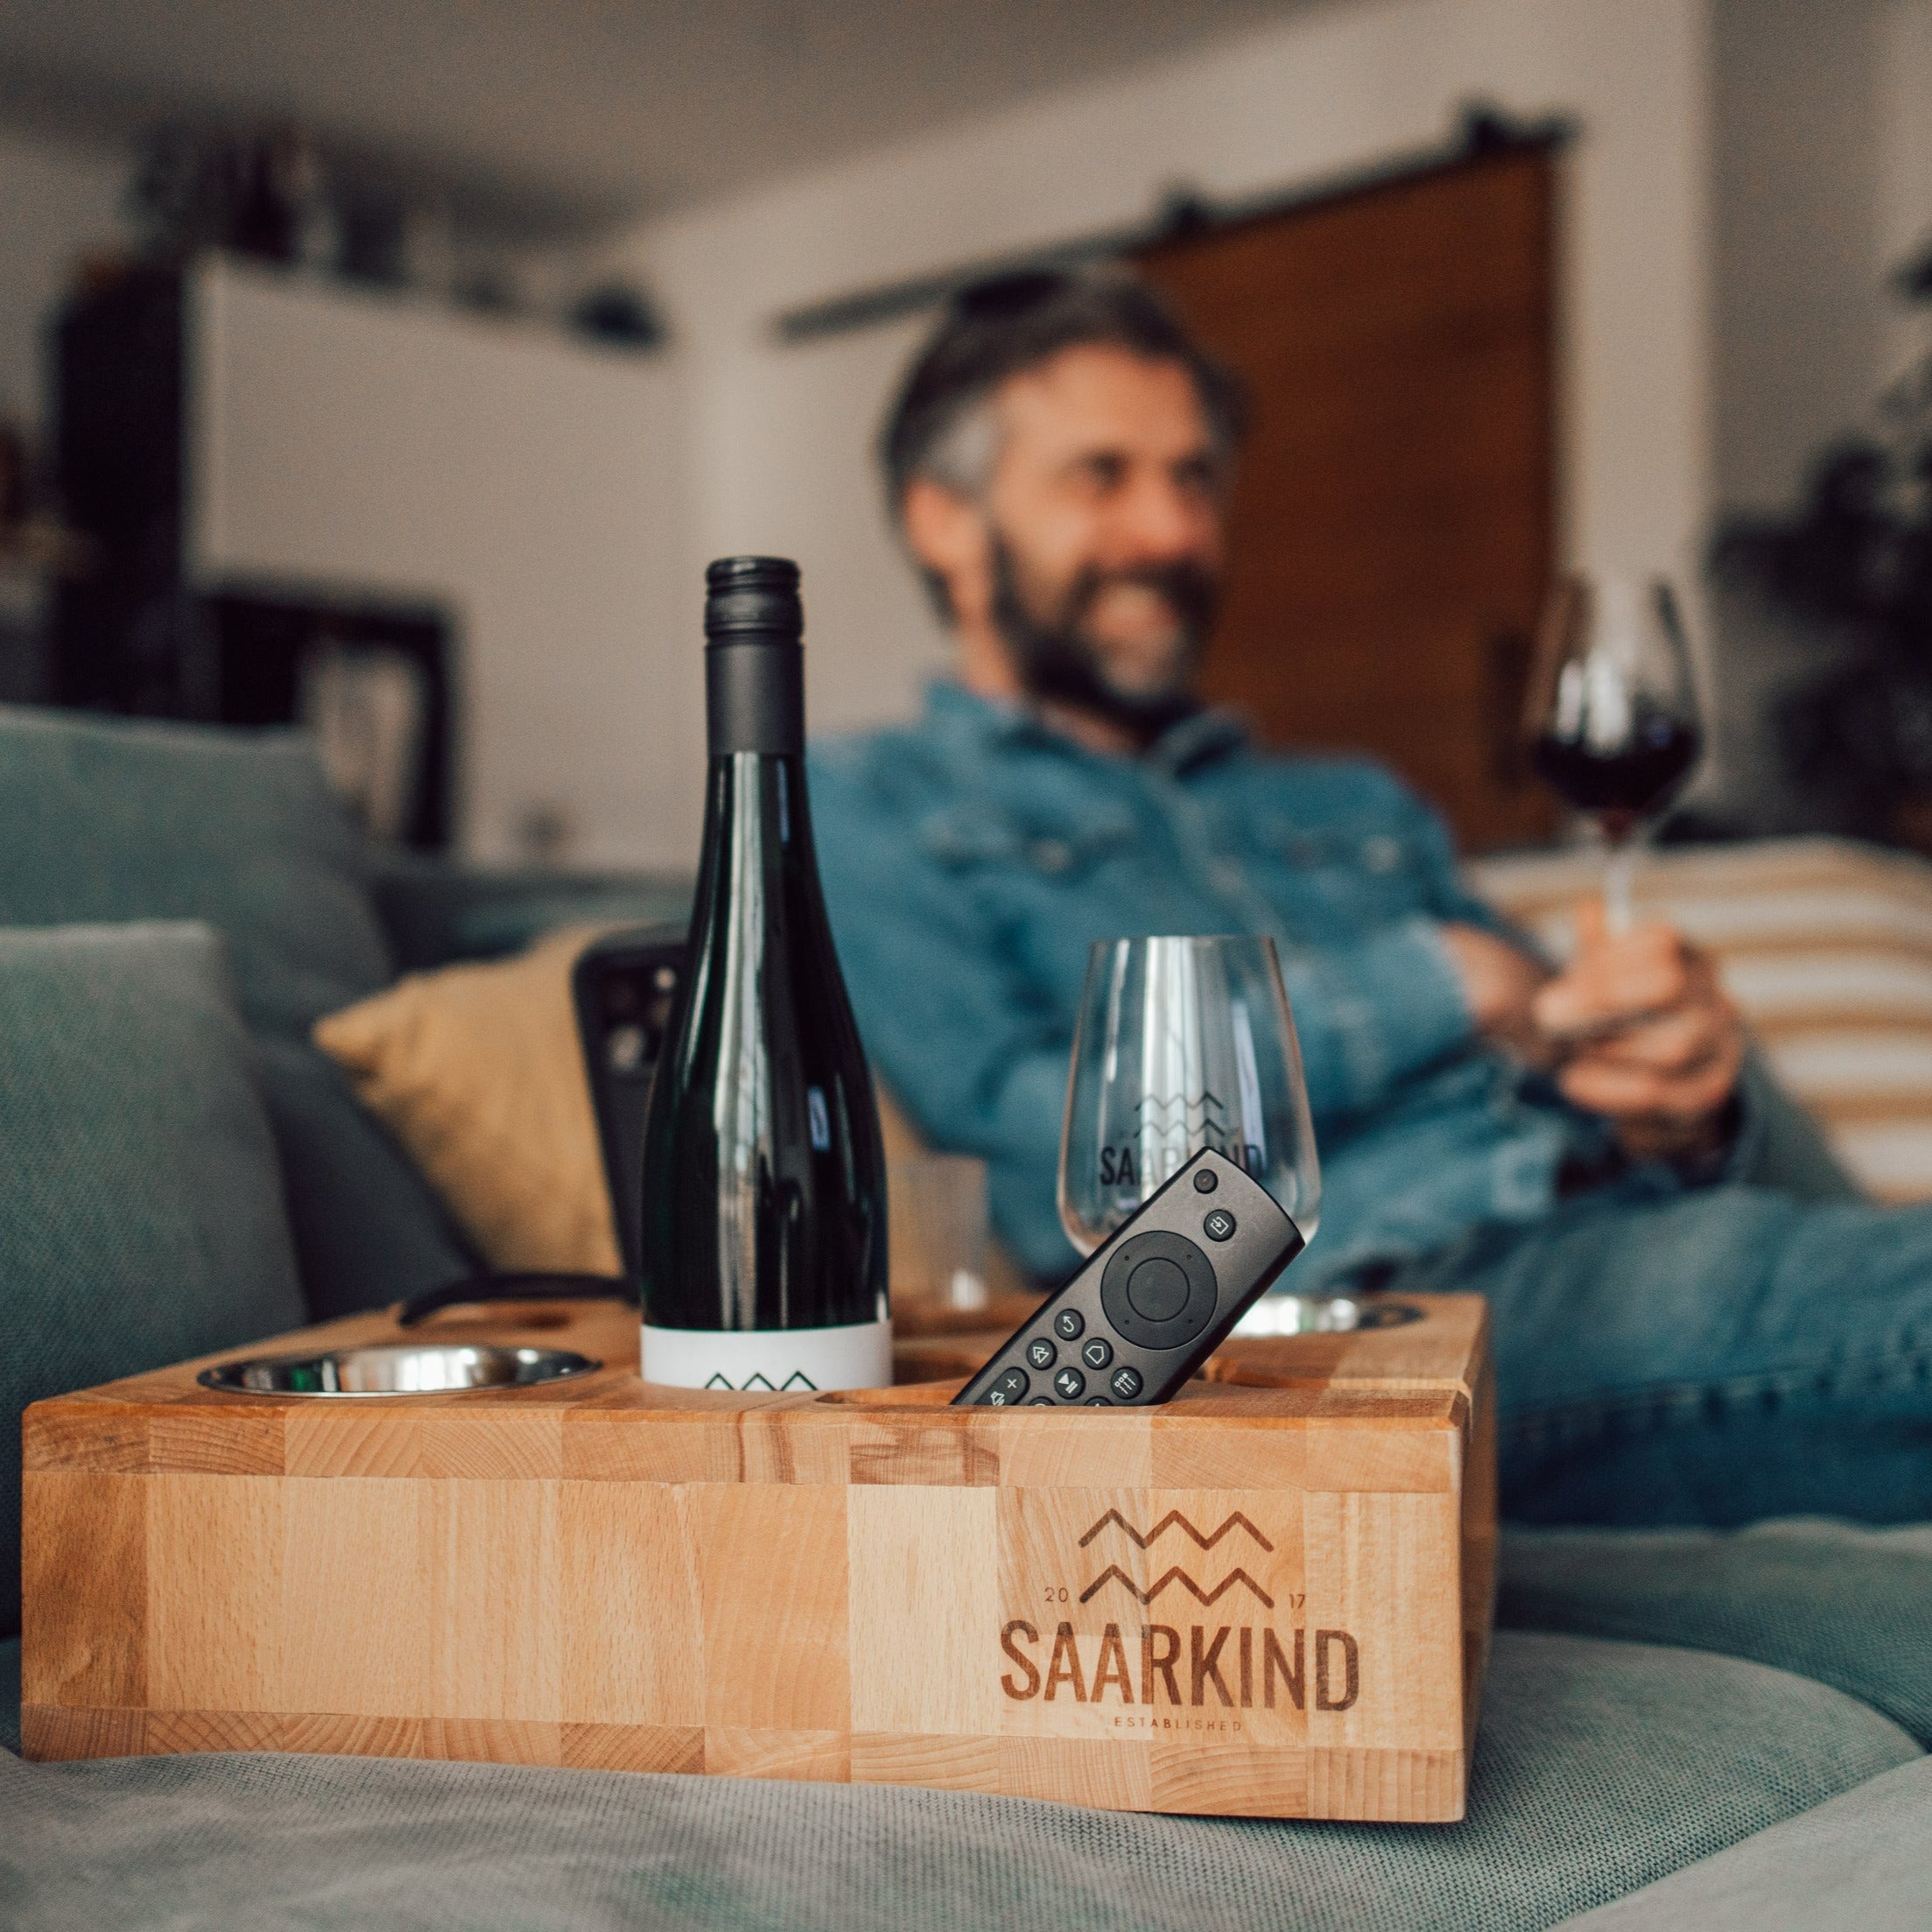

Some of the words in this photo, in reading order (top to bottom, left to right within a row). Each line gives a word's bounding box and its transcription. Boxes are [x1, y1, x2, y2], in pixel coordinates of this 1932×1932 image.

[1044, 1586, 1069, 1603] 20
[1289, 1593, 1305, 1609] 17
[1000, 1619, 1359, 1711] SAARKIND
[1114, 1716, 1242, 1732] ESTABLISHED
